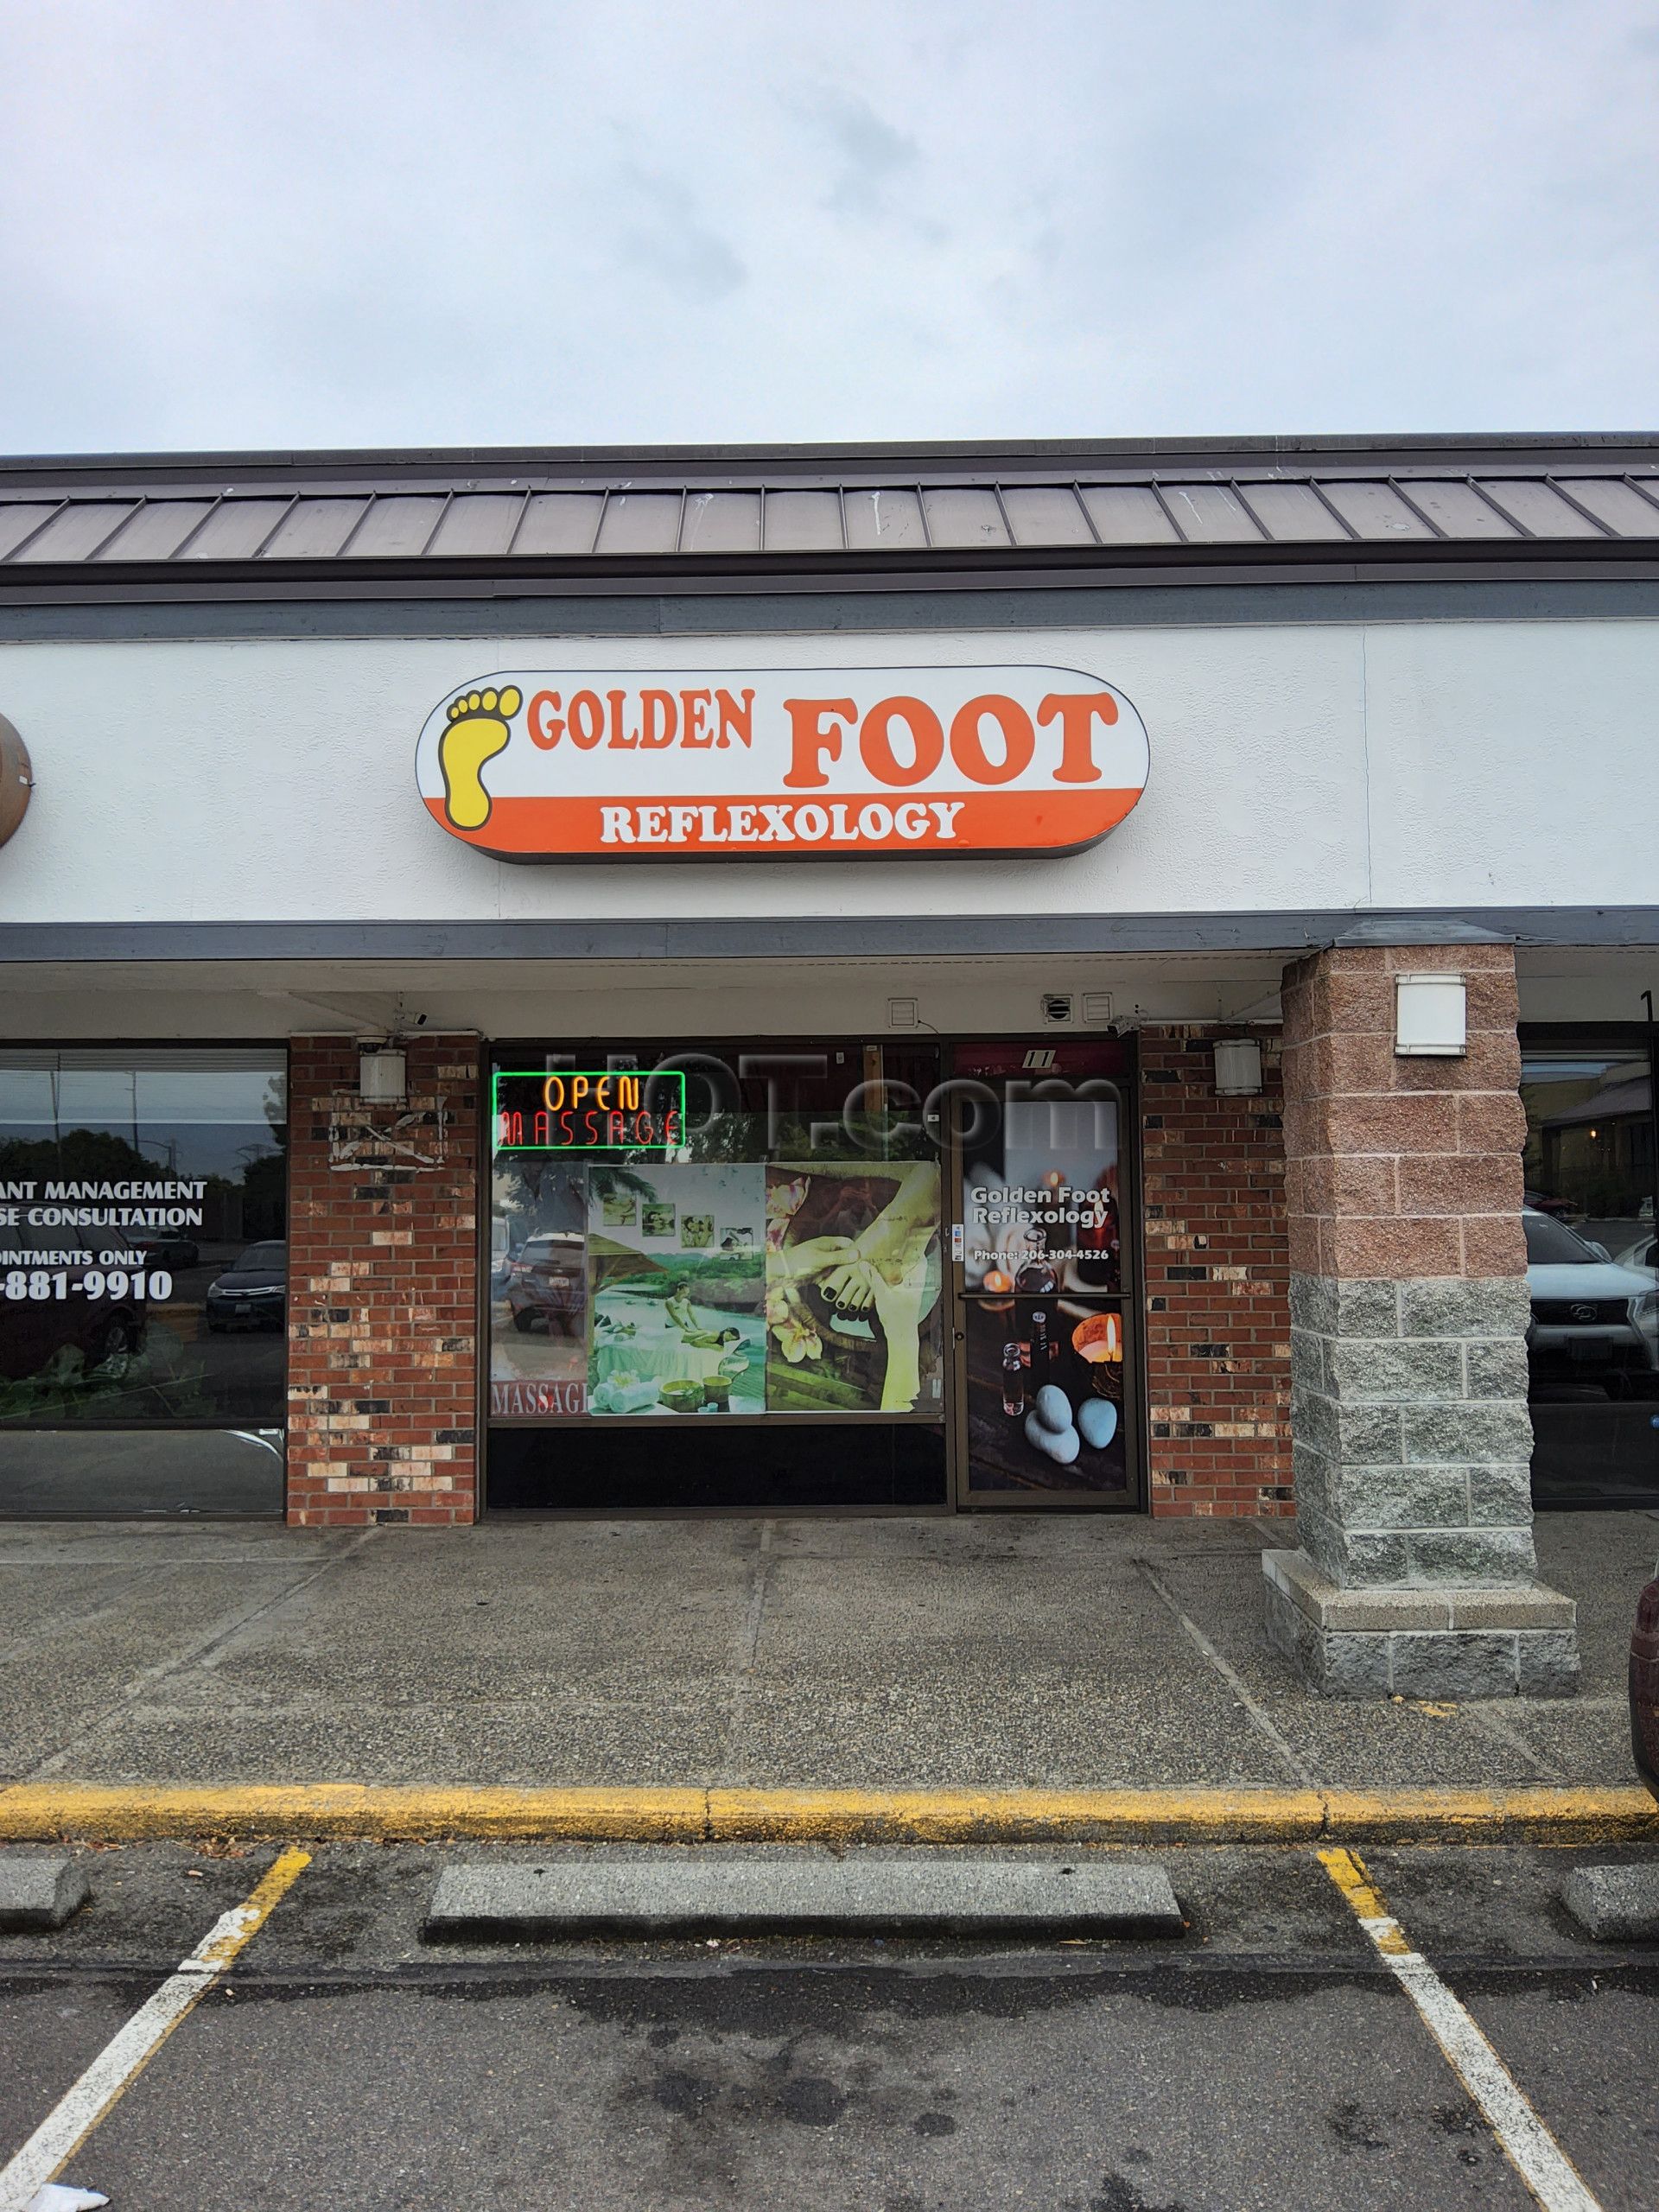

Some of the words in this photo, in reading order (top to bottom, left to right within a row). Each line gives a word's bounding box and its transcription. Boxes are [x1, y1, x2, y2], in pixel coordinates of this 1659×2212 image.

[527, 689, 754, 751] GOLDEN
[783, 692, 1118, 787] FOOT
[601, 802, 964, 843] REFLEXOLOGY
[543, 1076, 639, 1111] OPEN
[499, 1111, 677, 1146] MASSAGE
[44, 1181, 208, 1200] MANAGEMENT
[970, 1186, 1052, 1204] Golden
[1058, 1186, 1110, 1204] Foot
[28, 1208, 203, 1226] CONSULTATION
[973, 1207, 1109, 1229] Reflexology
[0, 1250, 93, 1265] INTMENTS
[99, 1250, 147, 1265] ONLY
[974, 1249, 1018, 1261] Phone:
[1021, 1249, 1109, 1261] 206-304-4526
